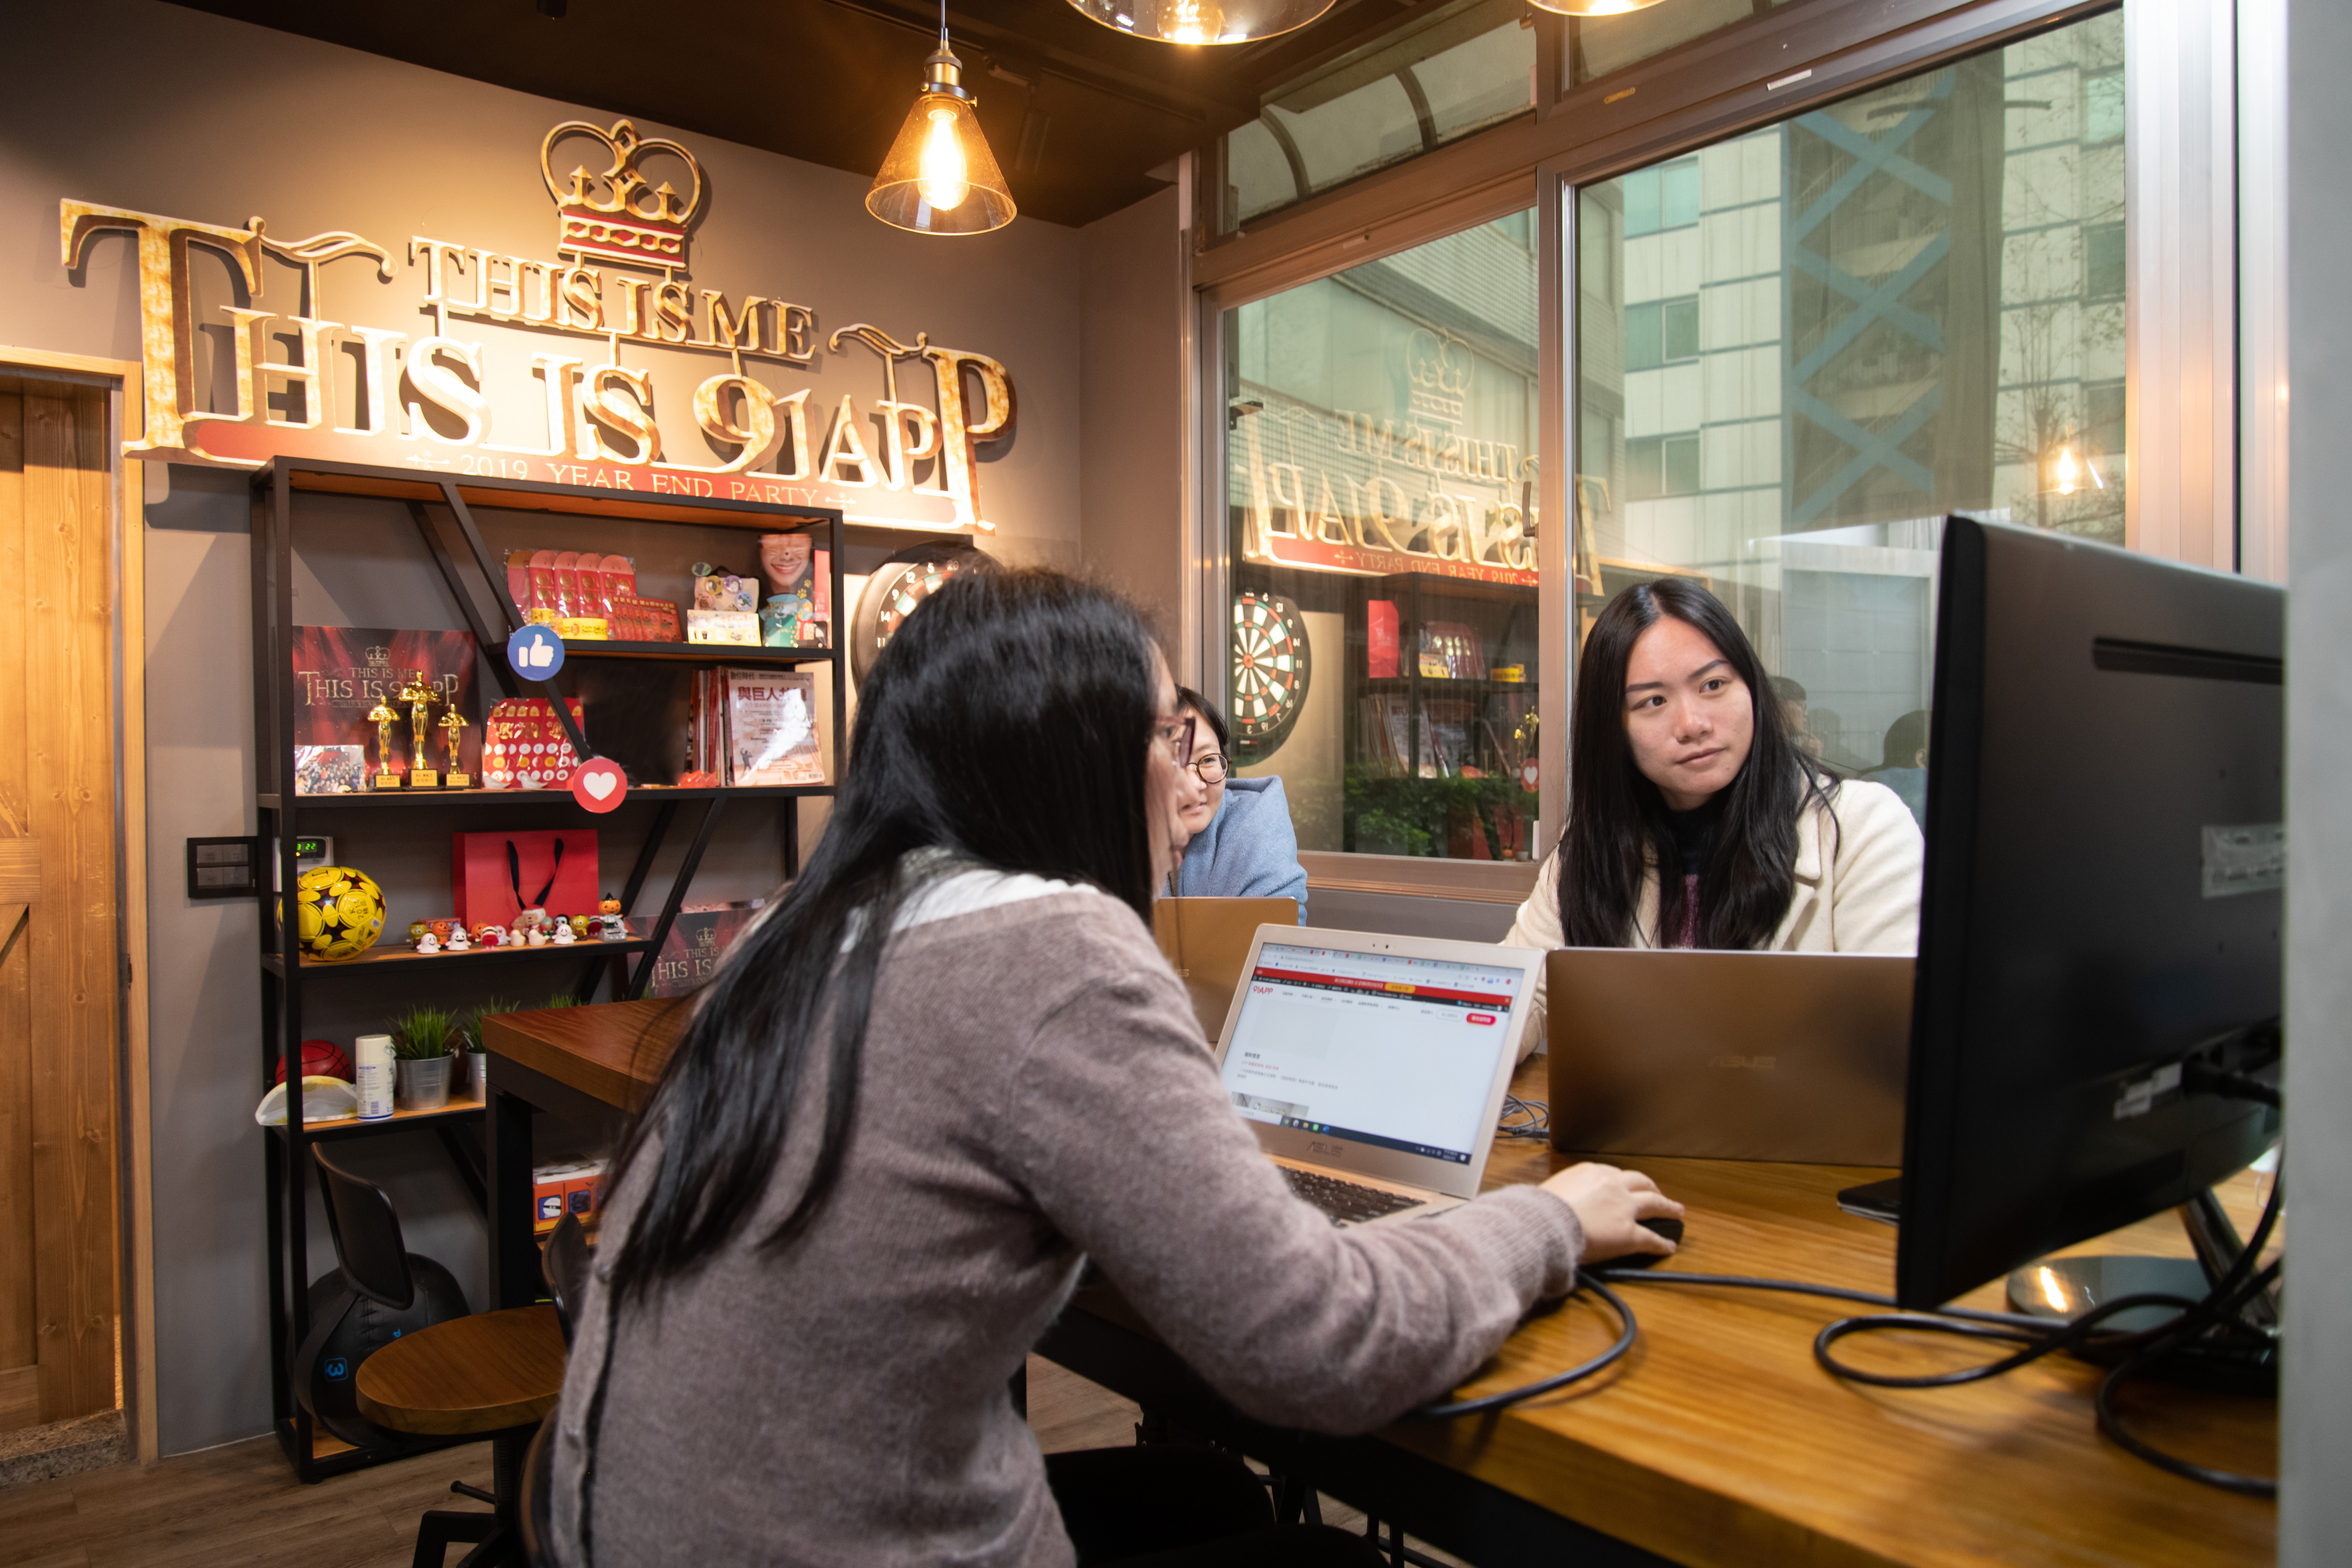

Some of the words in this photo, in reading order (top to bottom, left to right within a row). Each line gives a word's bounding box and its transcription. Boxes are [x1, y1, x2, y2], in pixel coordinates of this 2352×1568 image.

[411, 235, 604, 330] THIS
[615, 276, 692, 343] IS
[686, 289, 817, 362] ME
[59, 198, 493, 458] THIS
[533, 352, 662, 465] IS
[693, 345, 1018, 536] 91APP
[460, 454, 528, 480] 2019
[546, 462, 634, 491] YEAR
[652, 473, 713, 498] END
[729, 482, 819, 507] PARTY
[927, 563, 934, 573] 5
[906, 571, 915, 583] 12
[892, 589, 899, 601] 9
[880, 610, 890, 622] 14
[348, 667, 378, 678] THIS
[382, 668, 394, 679] IS
[398, 669, 417, 679] ME
[298, 671, 353, 706] THIS
[362, 681, 383, 699] IS
[684, 948, 707, 959] THIS
[710, 947, 719, 957] IS
[695, 959, 711, 977] IS
[1253, 985, 1273, 995] 91APP
